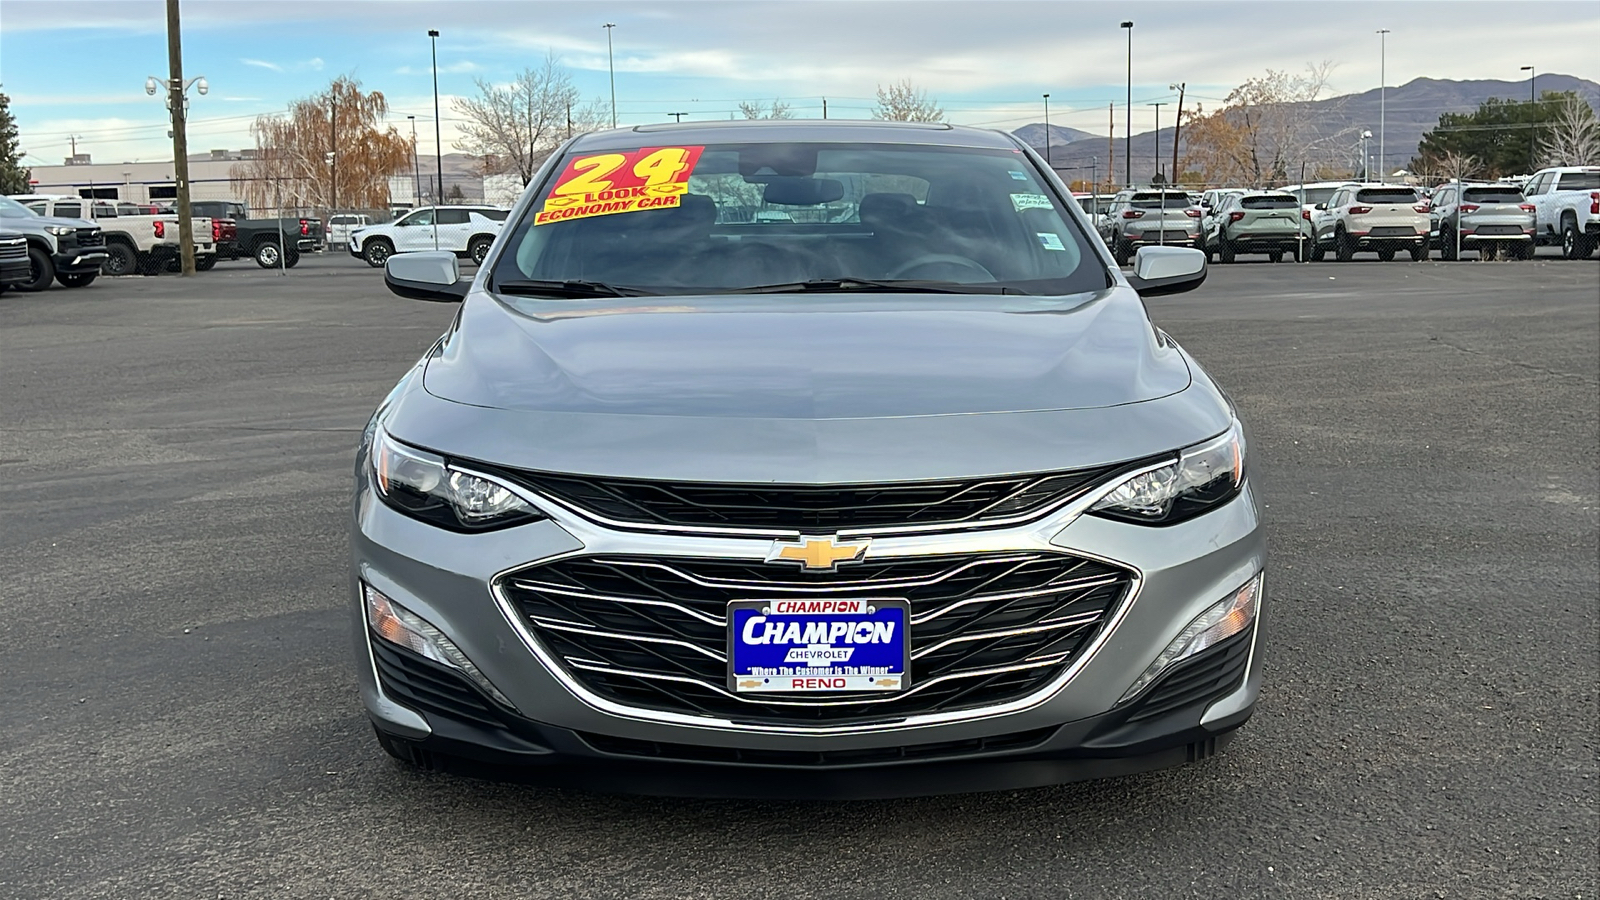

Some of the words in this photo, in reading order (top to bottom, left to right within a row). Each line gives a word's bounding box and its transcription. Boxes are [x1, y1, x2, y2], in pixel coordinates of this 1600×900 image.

[555, 148, 691, 196] 24
[584, 187, 650, 204] LOOK
[537, 200, 635, 223] ECONOMY
[637, 195, 679, 208] CAR
[776, 601, 860, 613] CHAMPION
[742, 616, 895, 645] CHAMPION
[789, 650, 849, 659] CHEVROLET
[778, 666, 794, 676] The
[796, 666, 833, 676] Customer
[844, 666, 858, 675] The
[792, 678, 846, 689] RENO
